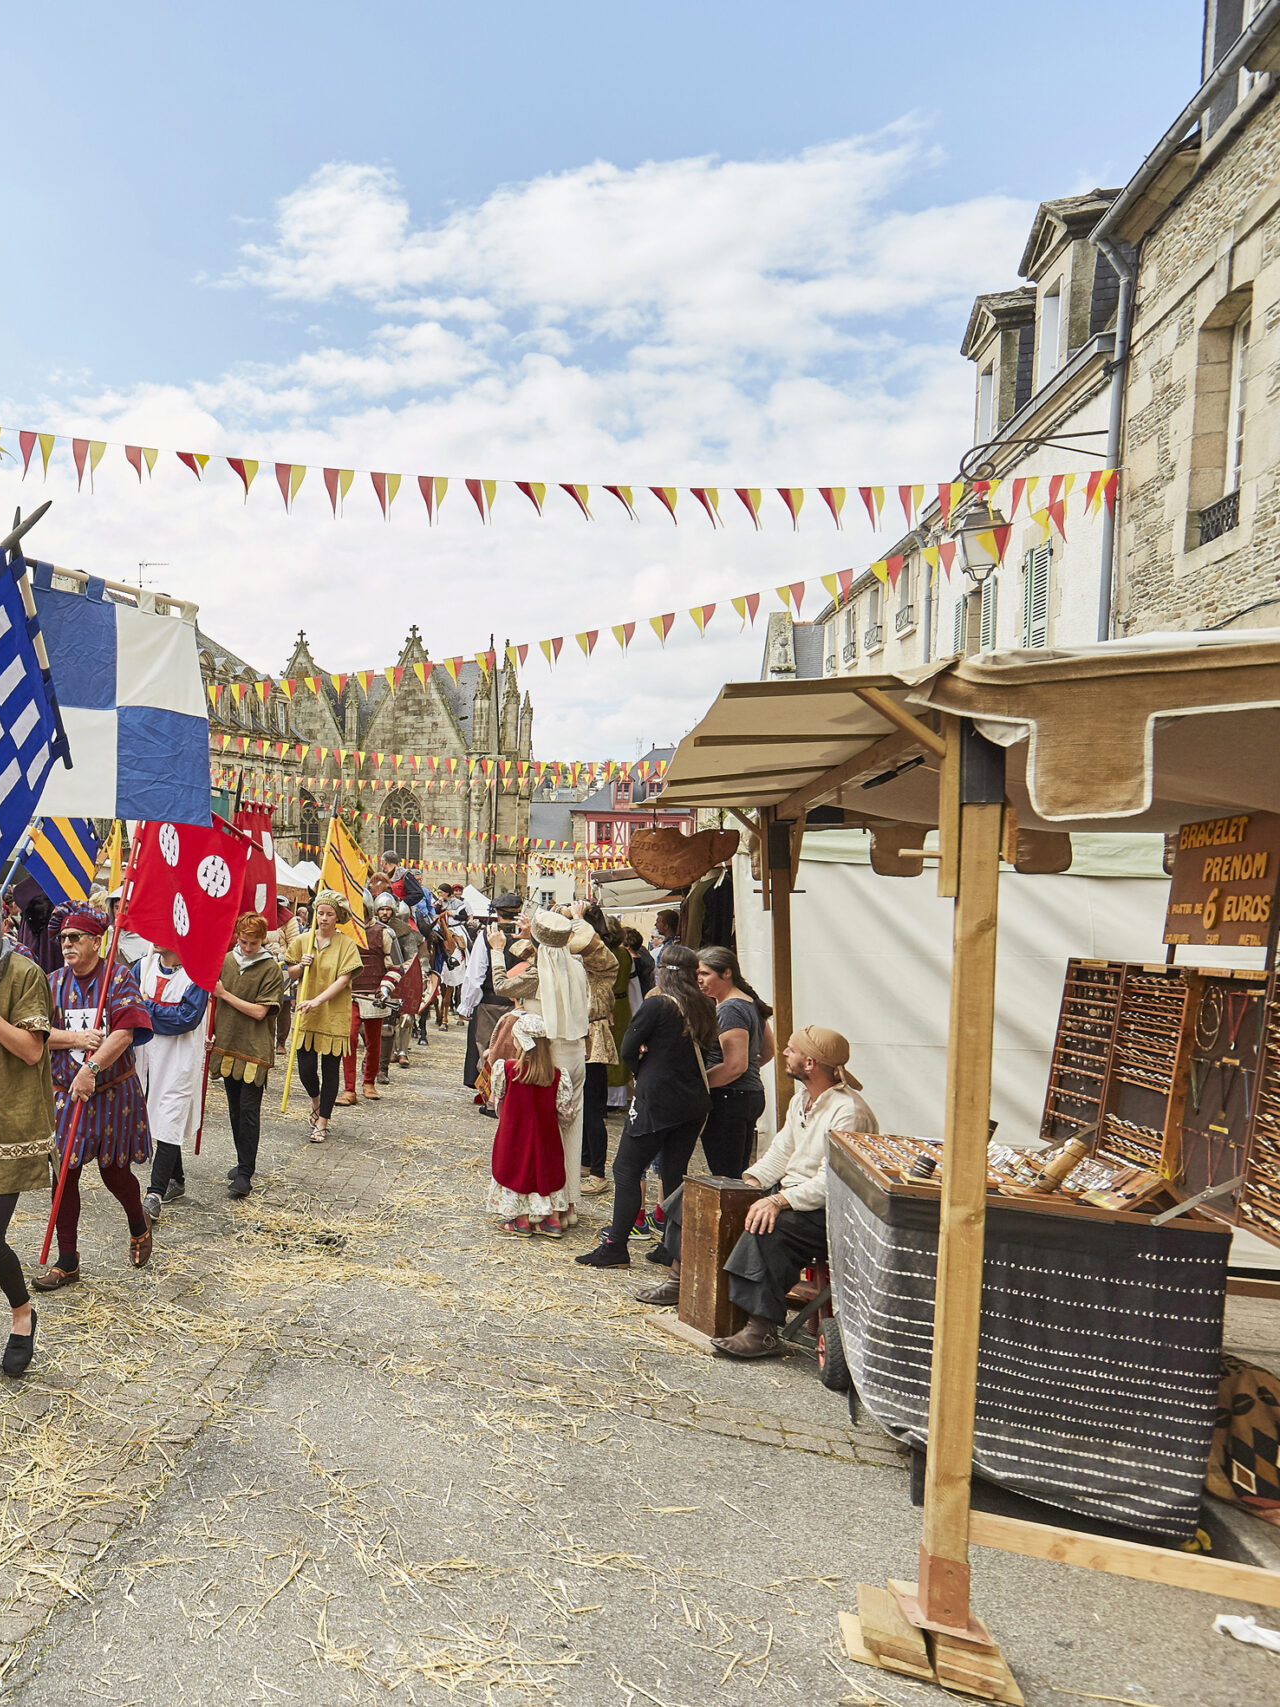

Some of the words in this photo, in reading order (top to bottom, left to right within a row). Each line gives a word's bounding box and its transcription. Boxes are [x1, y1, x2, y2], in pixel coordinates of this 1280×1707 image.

[1179, 816, 1248, 850] BRACELET
[1202, 852, 1269, 882] PRENOM
[1203, 887, 1219, 929] 6
[1223, 895, 1271, 922] EUROS
[1205, 934, 1220, 945] SUR
